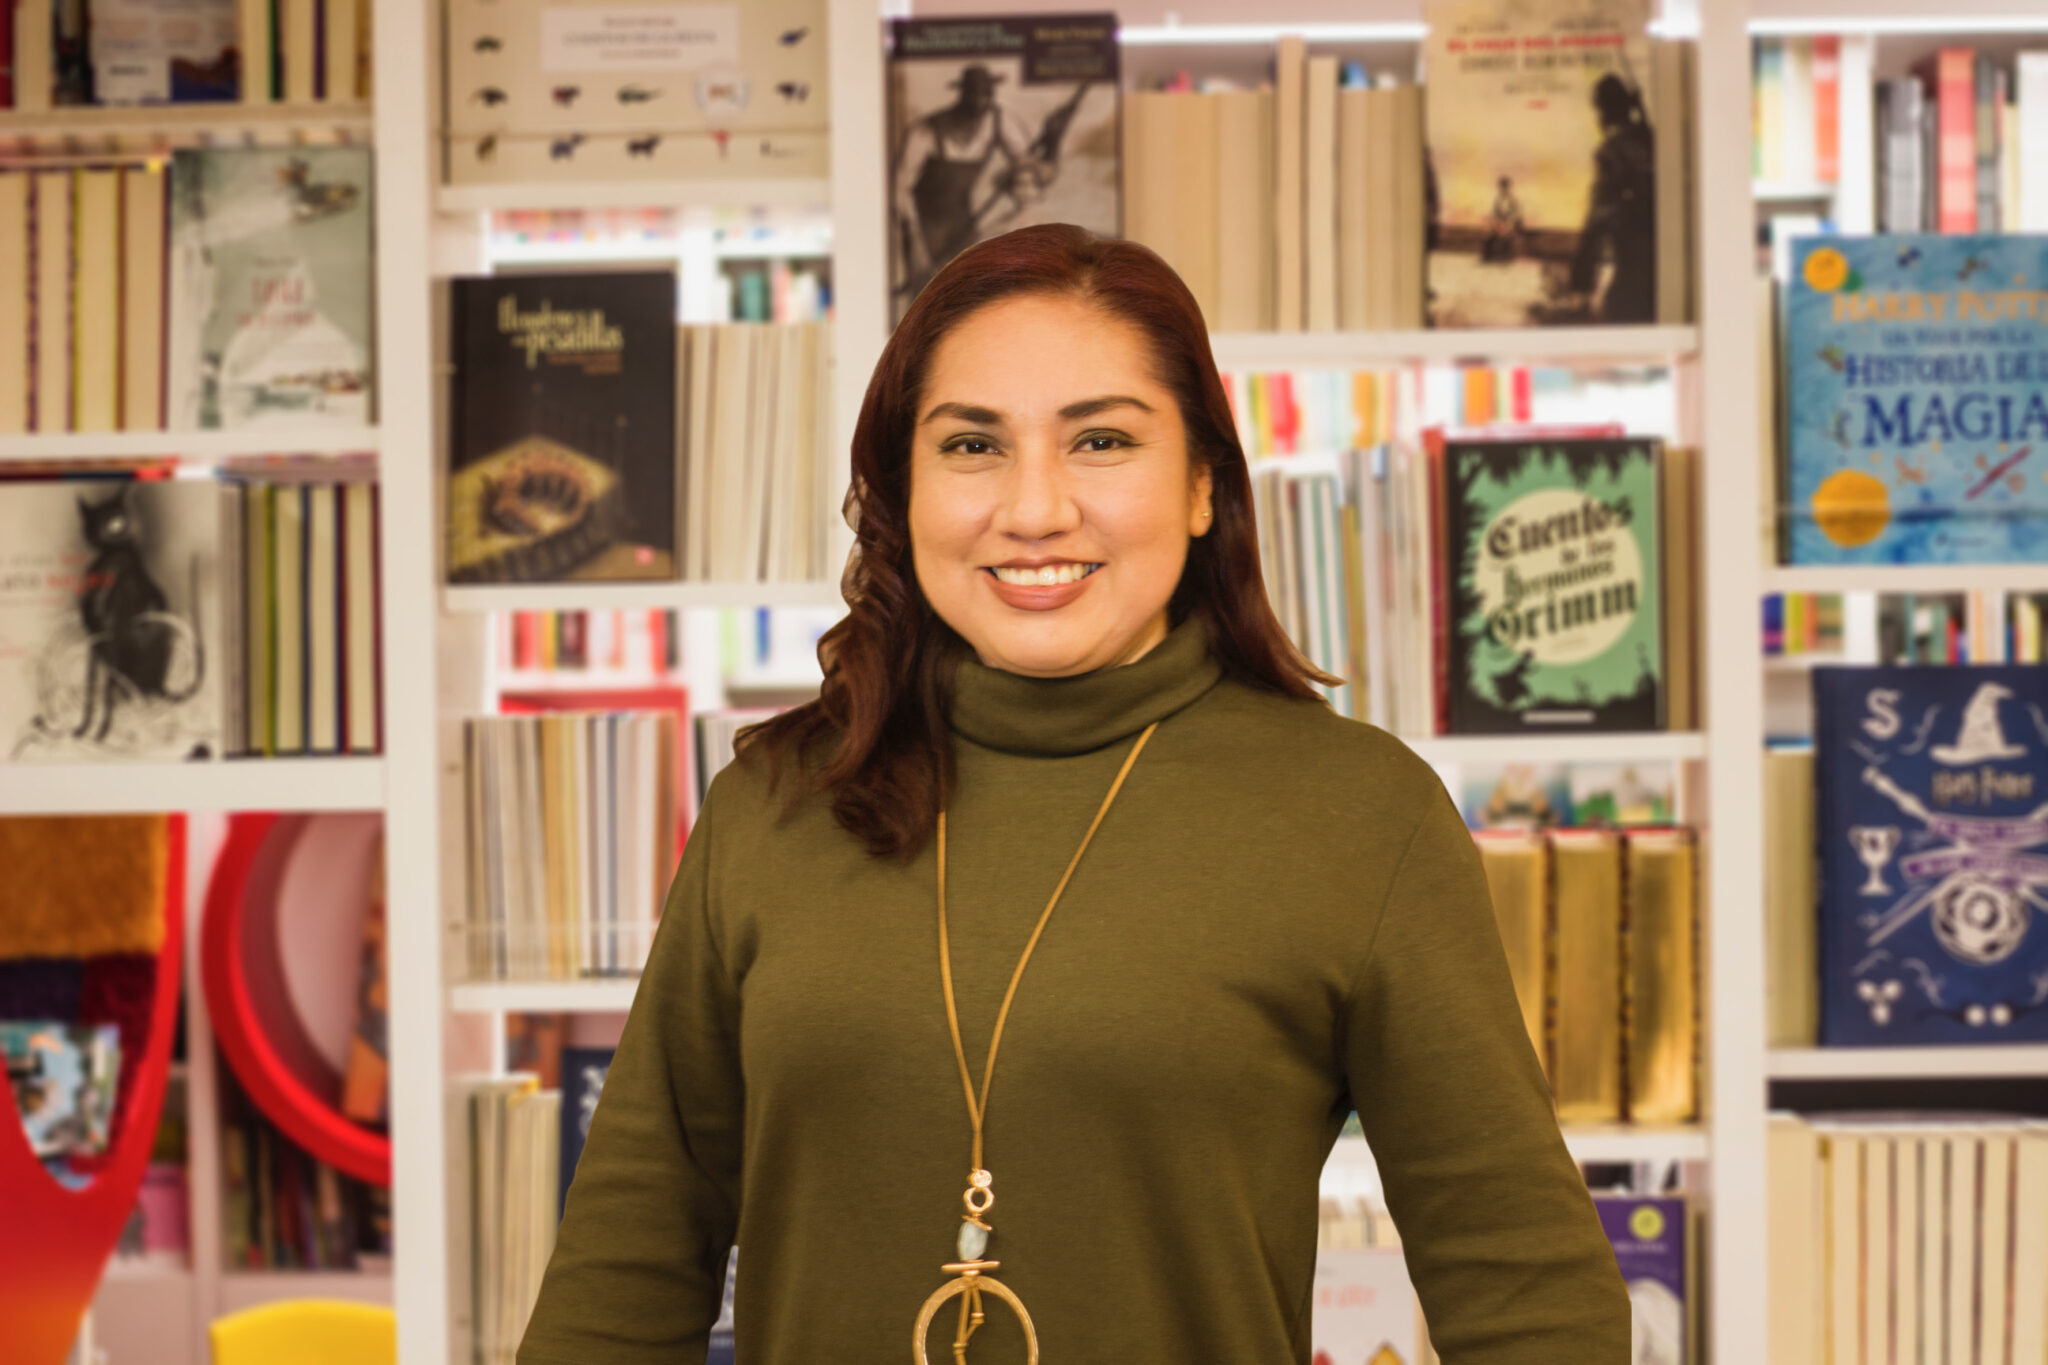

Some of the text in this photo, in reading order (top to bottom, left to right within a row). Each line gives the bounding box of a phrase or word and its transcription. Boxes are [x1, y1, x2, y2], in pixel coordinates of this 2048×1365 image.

[1833, 288, 2048, 324] HARRY POTT
[1846, 353, 1989, 387] HISTORIA
[1863, 390, 2048, 447] MAGIA
[1487, 497, 1634, 561] Cuentos
[1483, 578, 1637, 646] Grimm
